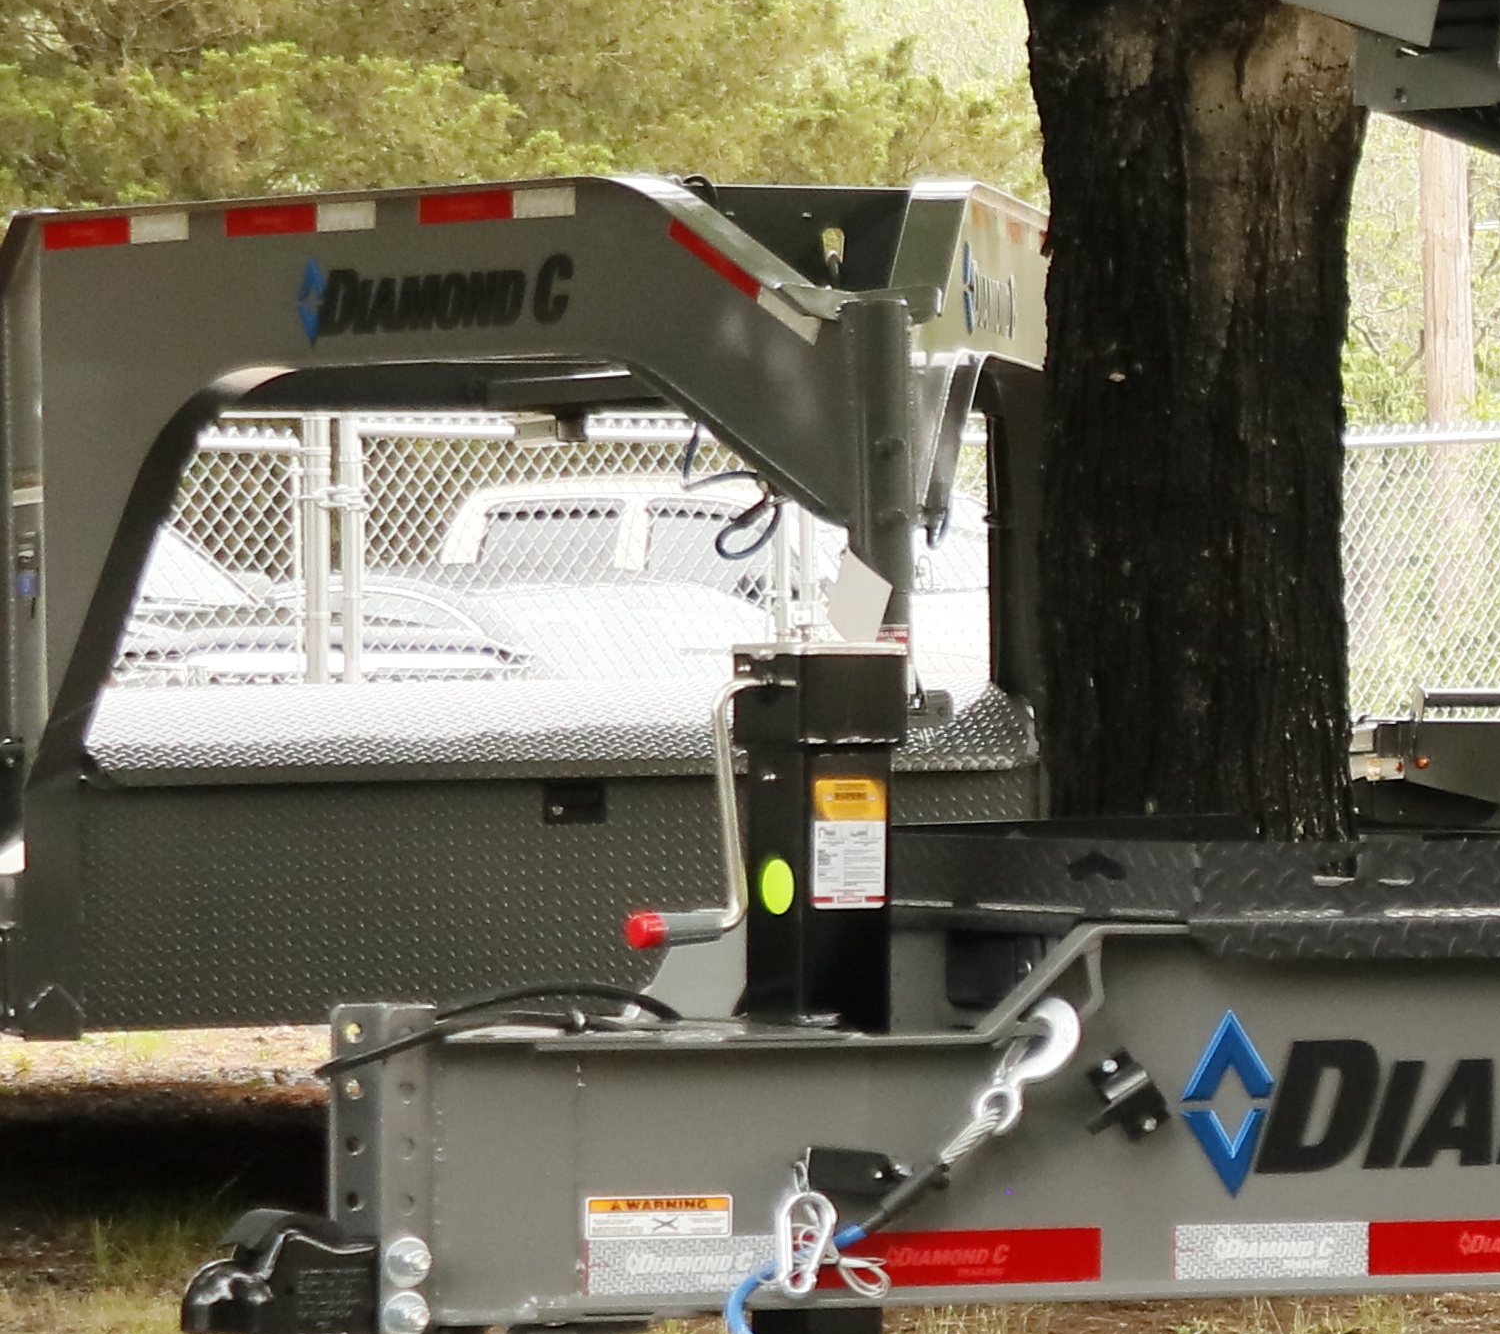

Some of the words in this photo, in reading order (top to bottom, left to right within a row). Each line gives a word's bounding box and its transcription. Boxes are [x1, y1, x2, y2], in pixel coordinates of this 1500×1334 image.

[319, 268, 526, 337] DIAMOND
[533, 253, 574, 326] C
[626, 1198, 708, 1211] WARNING
[900, 1246, 988, 1267] DIAMOND
[992, 1244, 1010, 1265] C
